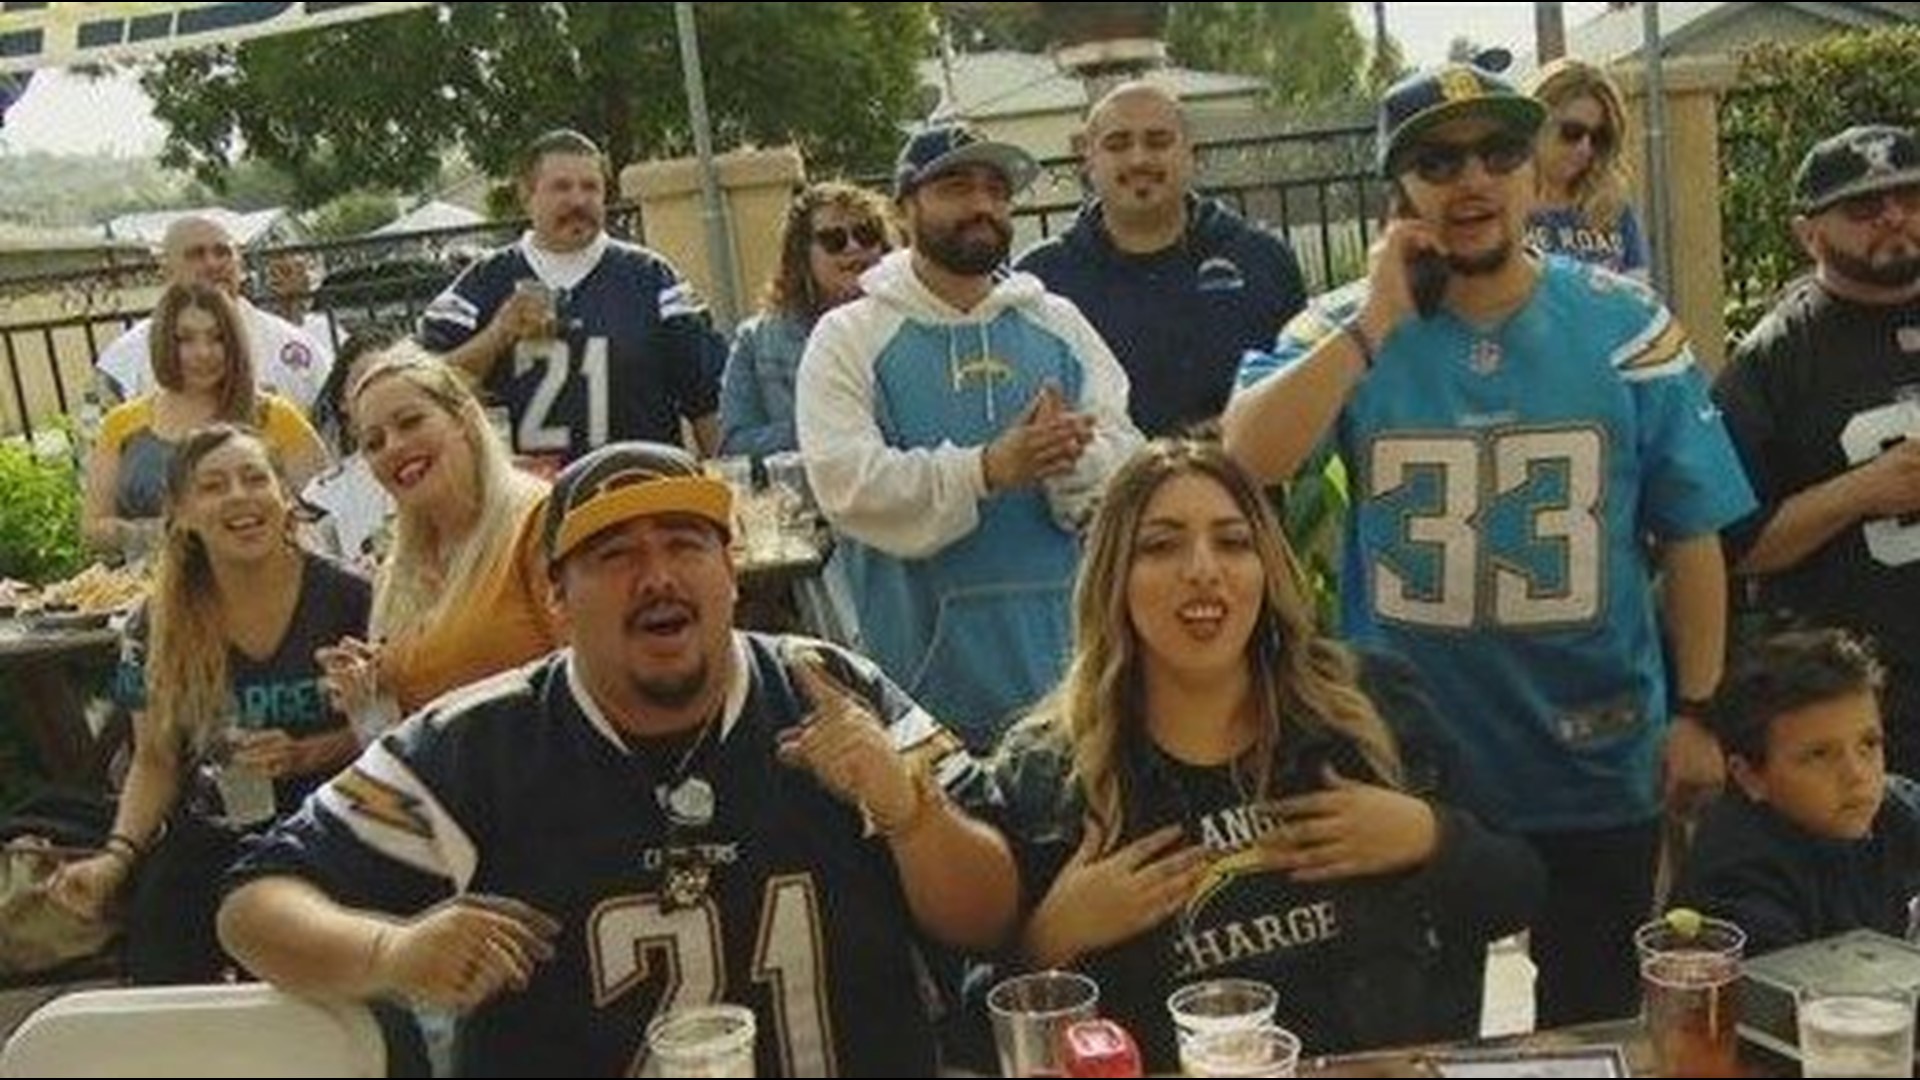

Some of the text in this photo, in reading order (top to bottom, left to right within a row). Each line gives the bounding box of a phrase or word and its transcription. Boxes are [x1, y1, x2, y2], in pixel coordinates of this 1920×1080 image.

[514, 337, 609, 450] 21
[1370, 424, 1607, 632] 33
[587, 872, 840, 1078] 21
